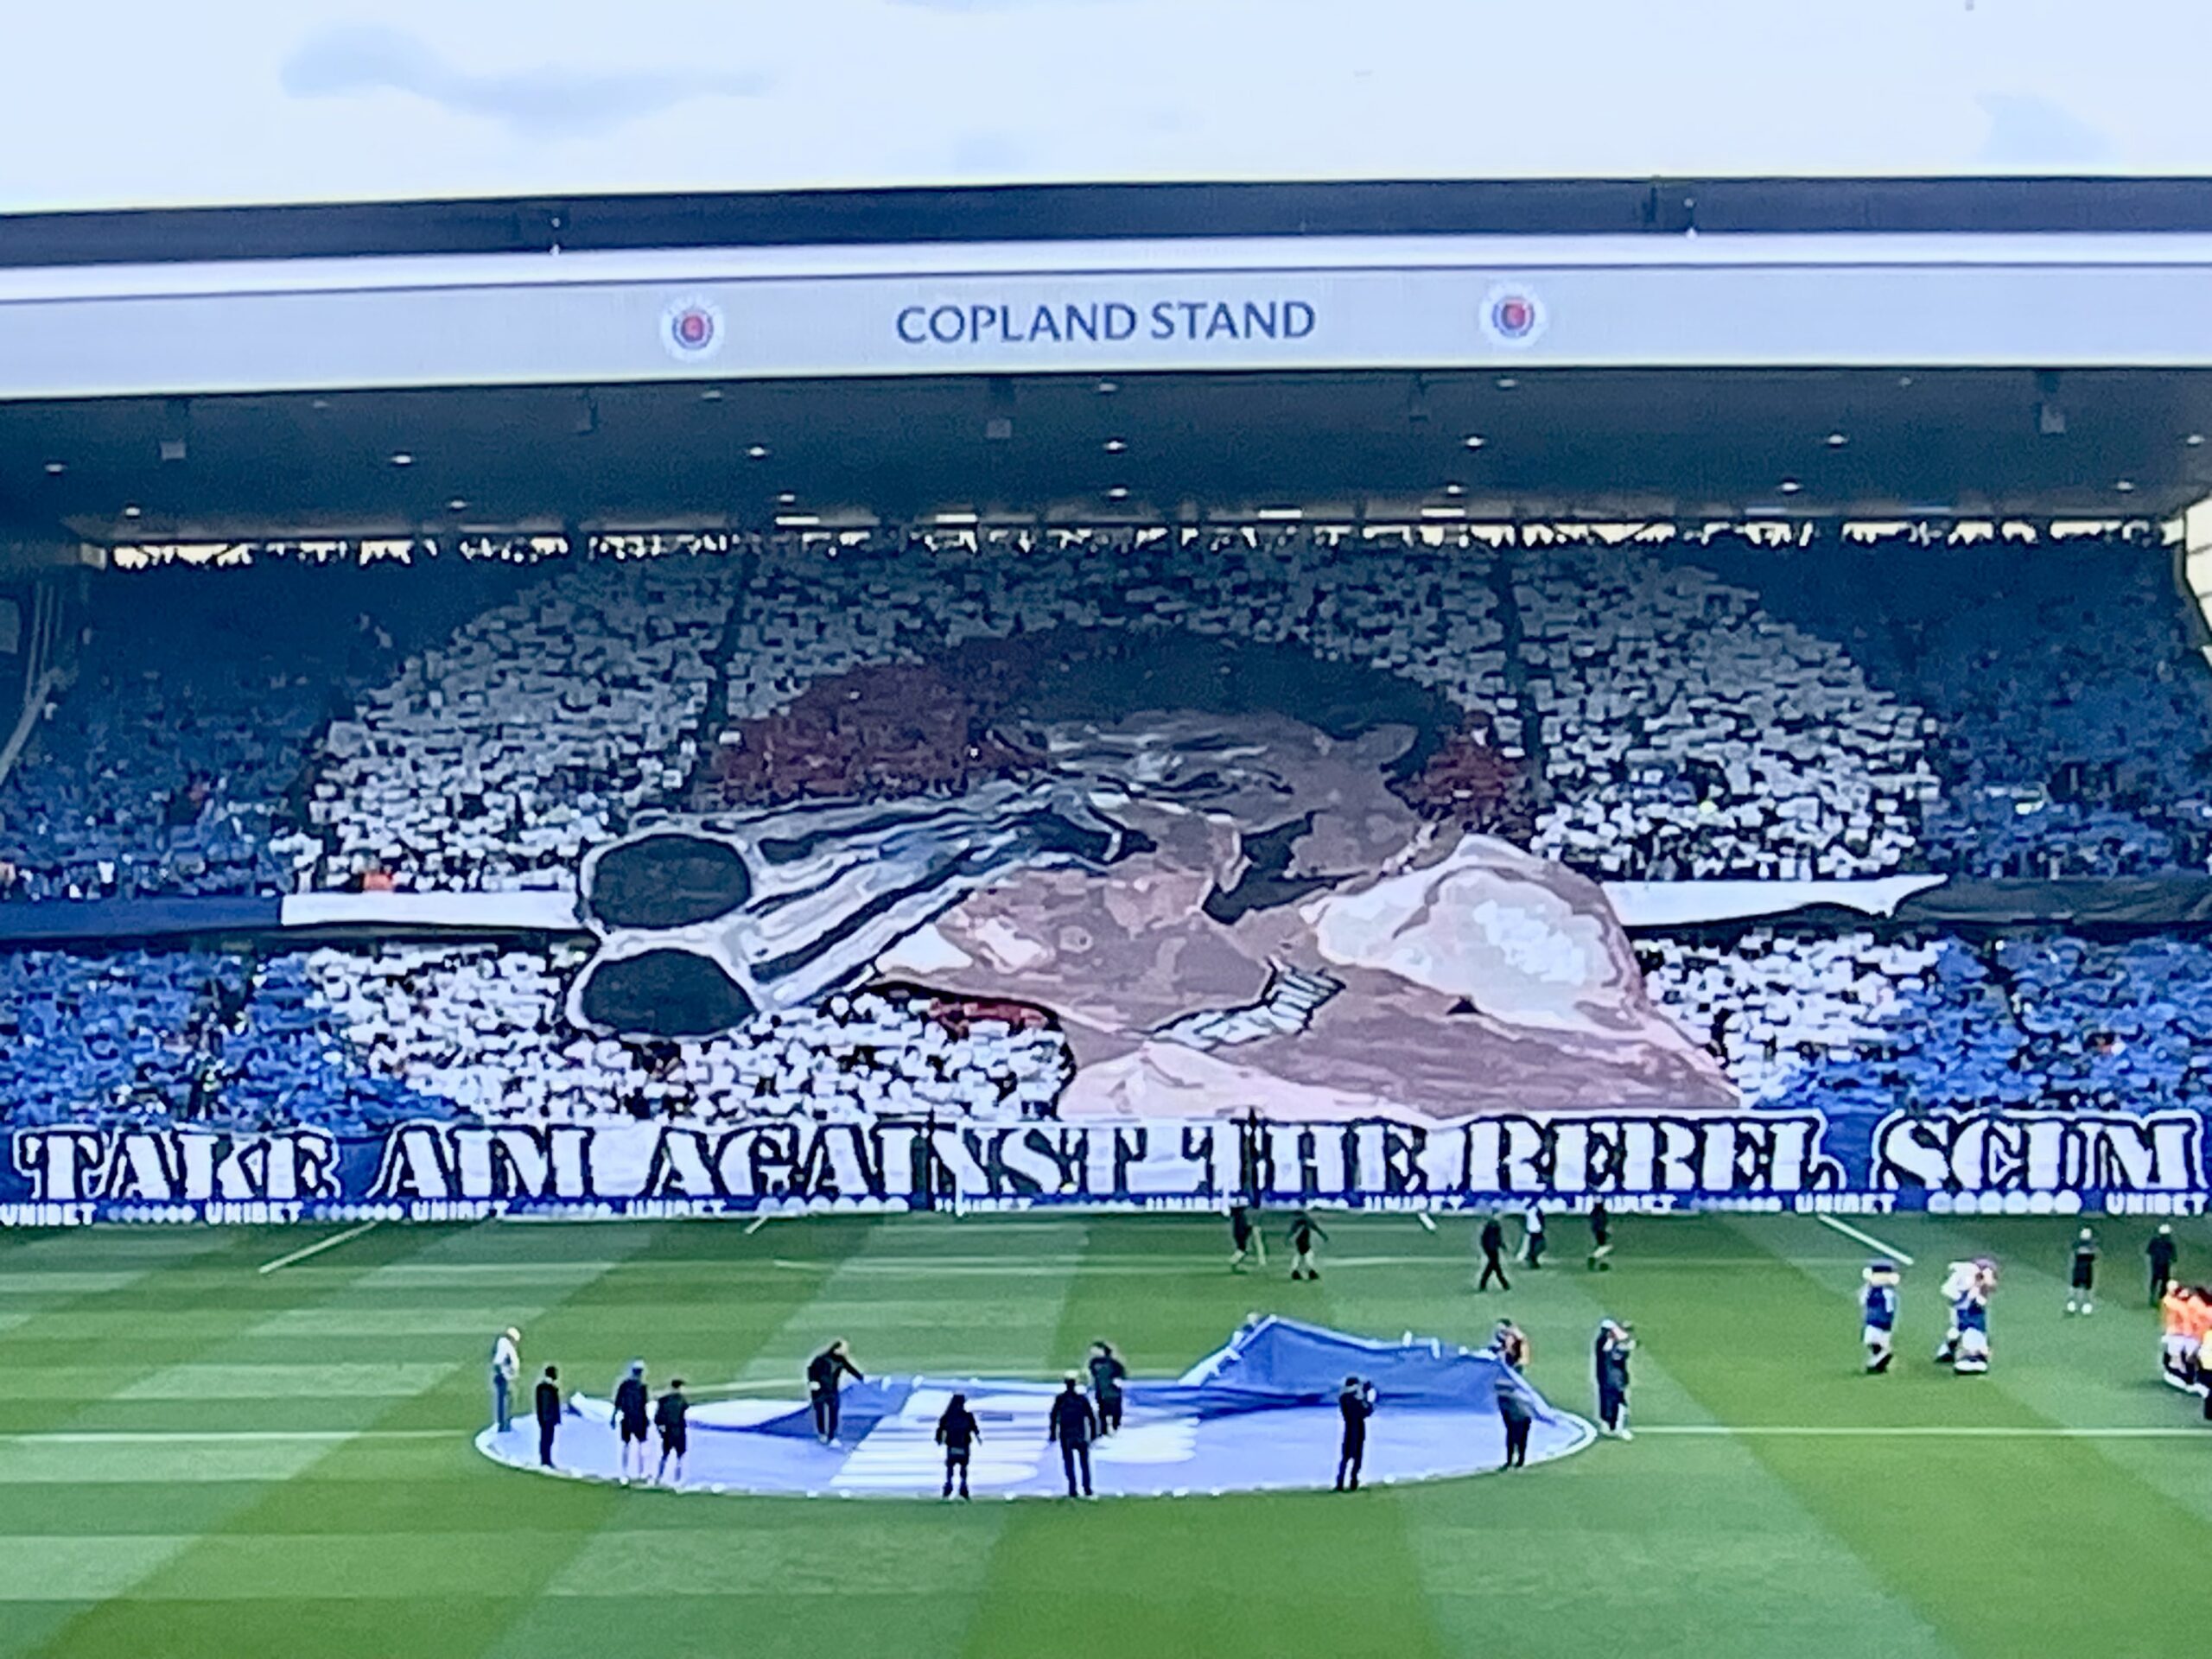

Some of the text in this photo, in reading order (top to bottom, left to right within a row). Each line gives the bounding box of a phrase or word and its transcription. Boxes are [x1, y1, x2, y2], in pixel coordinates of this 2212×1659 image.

[896, 300, 1317, 344] COPLAND STAND
[17, 1115, 2202, 1200] TAKE AIM AGAINST THE REBEL SCUM
